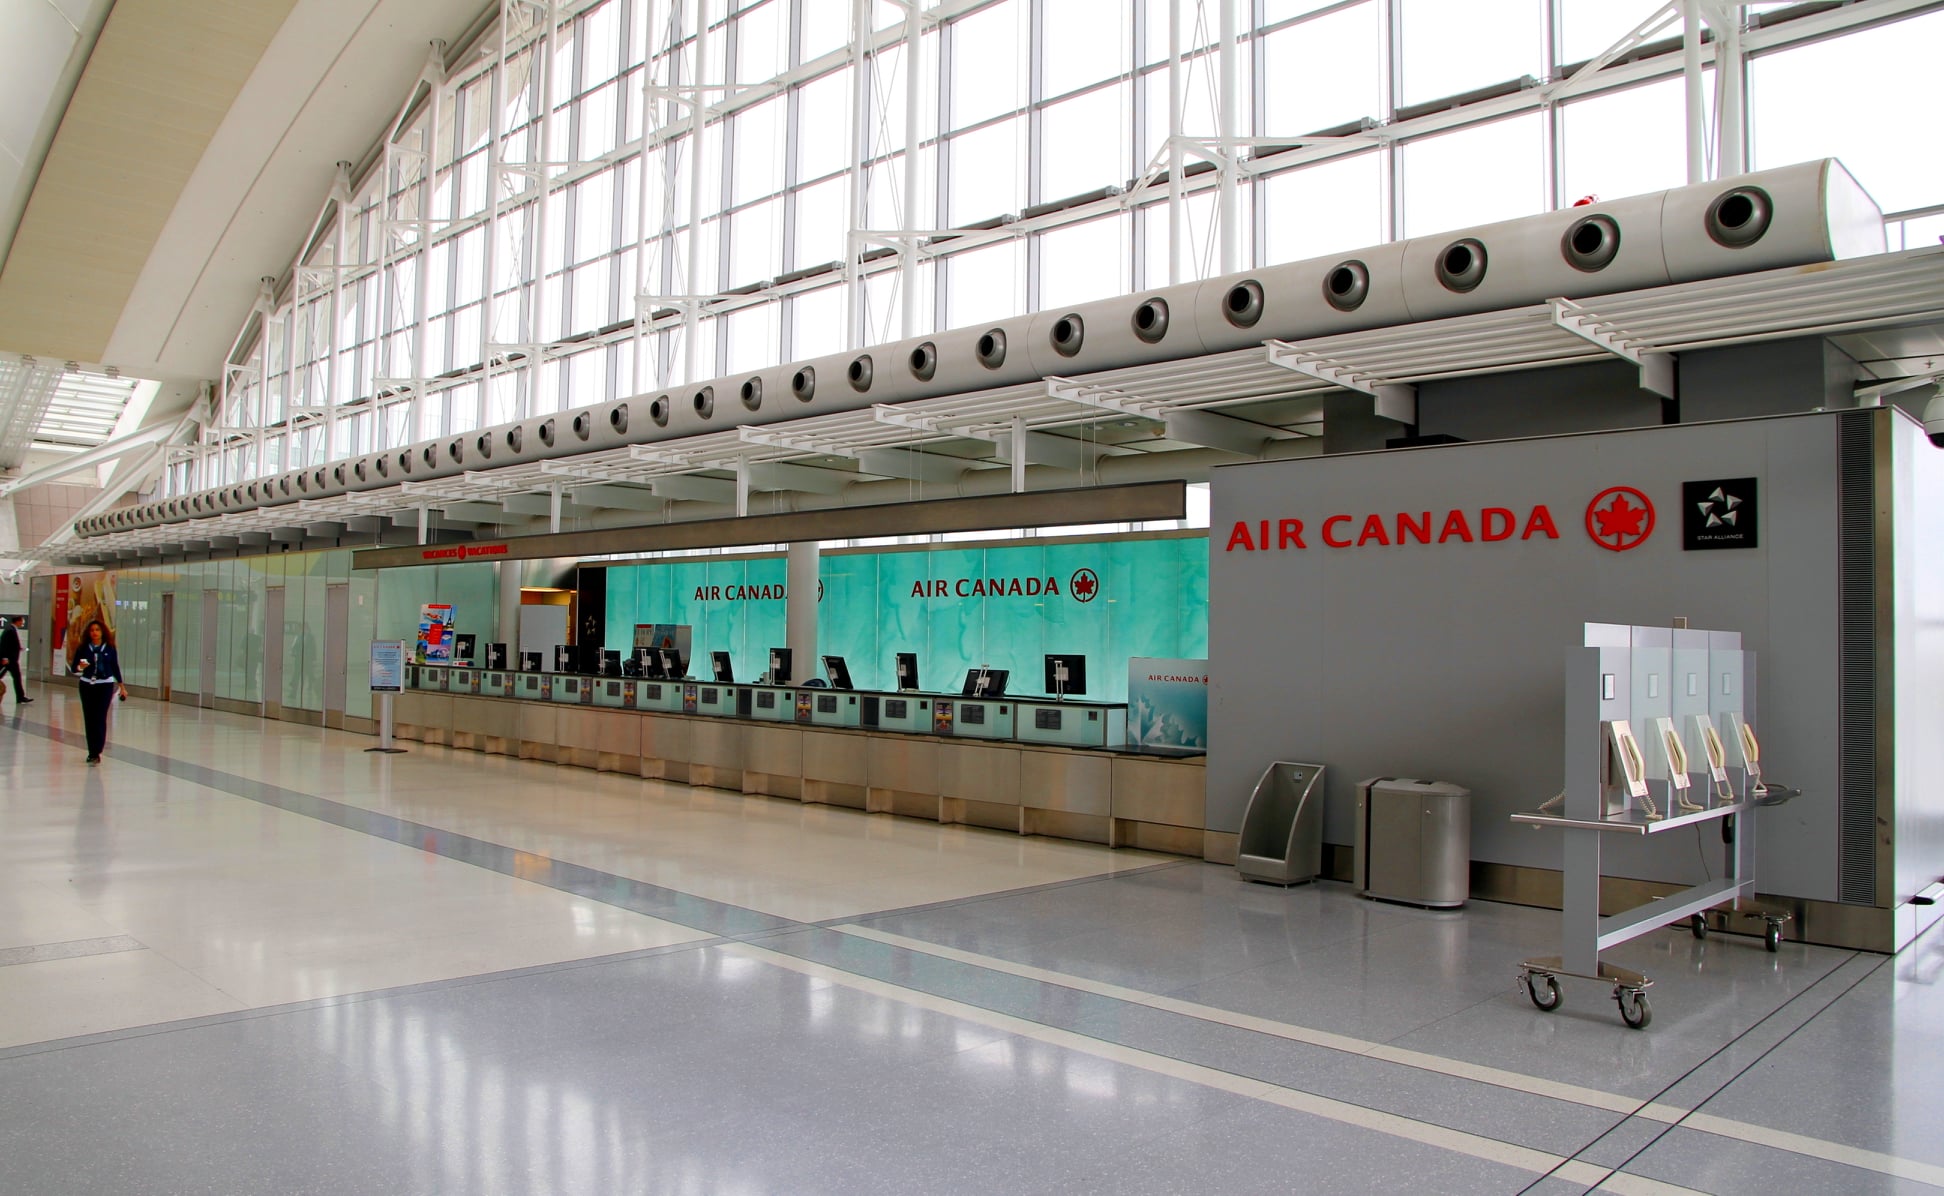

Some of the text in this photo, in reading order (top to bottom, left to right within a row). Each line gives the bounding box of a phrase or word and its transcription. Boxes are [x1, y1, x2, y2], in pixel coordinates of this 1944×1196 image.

[1226, 505, 1560, 551] AIR CANADA
[694, 584, 788, 601] AIR CANAD
[911, 576, 1060, 598] AIR CANADA
[1163, 675, 1200, 683] CANADA
